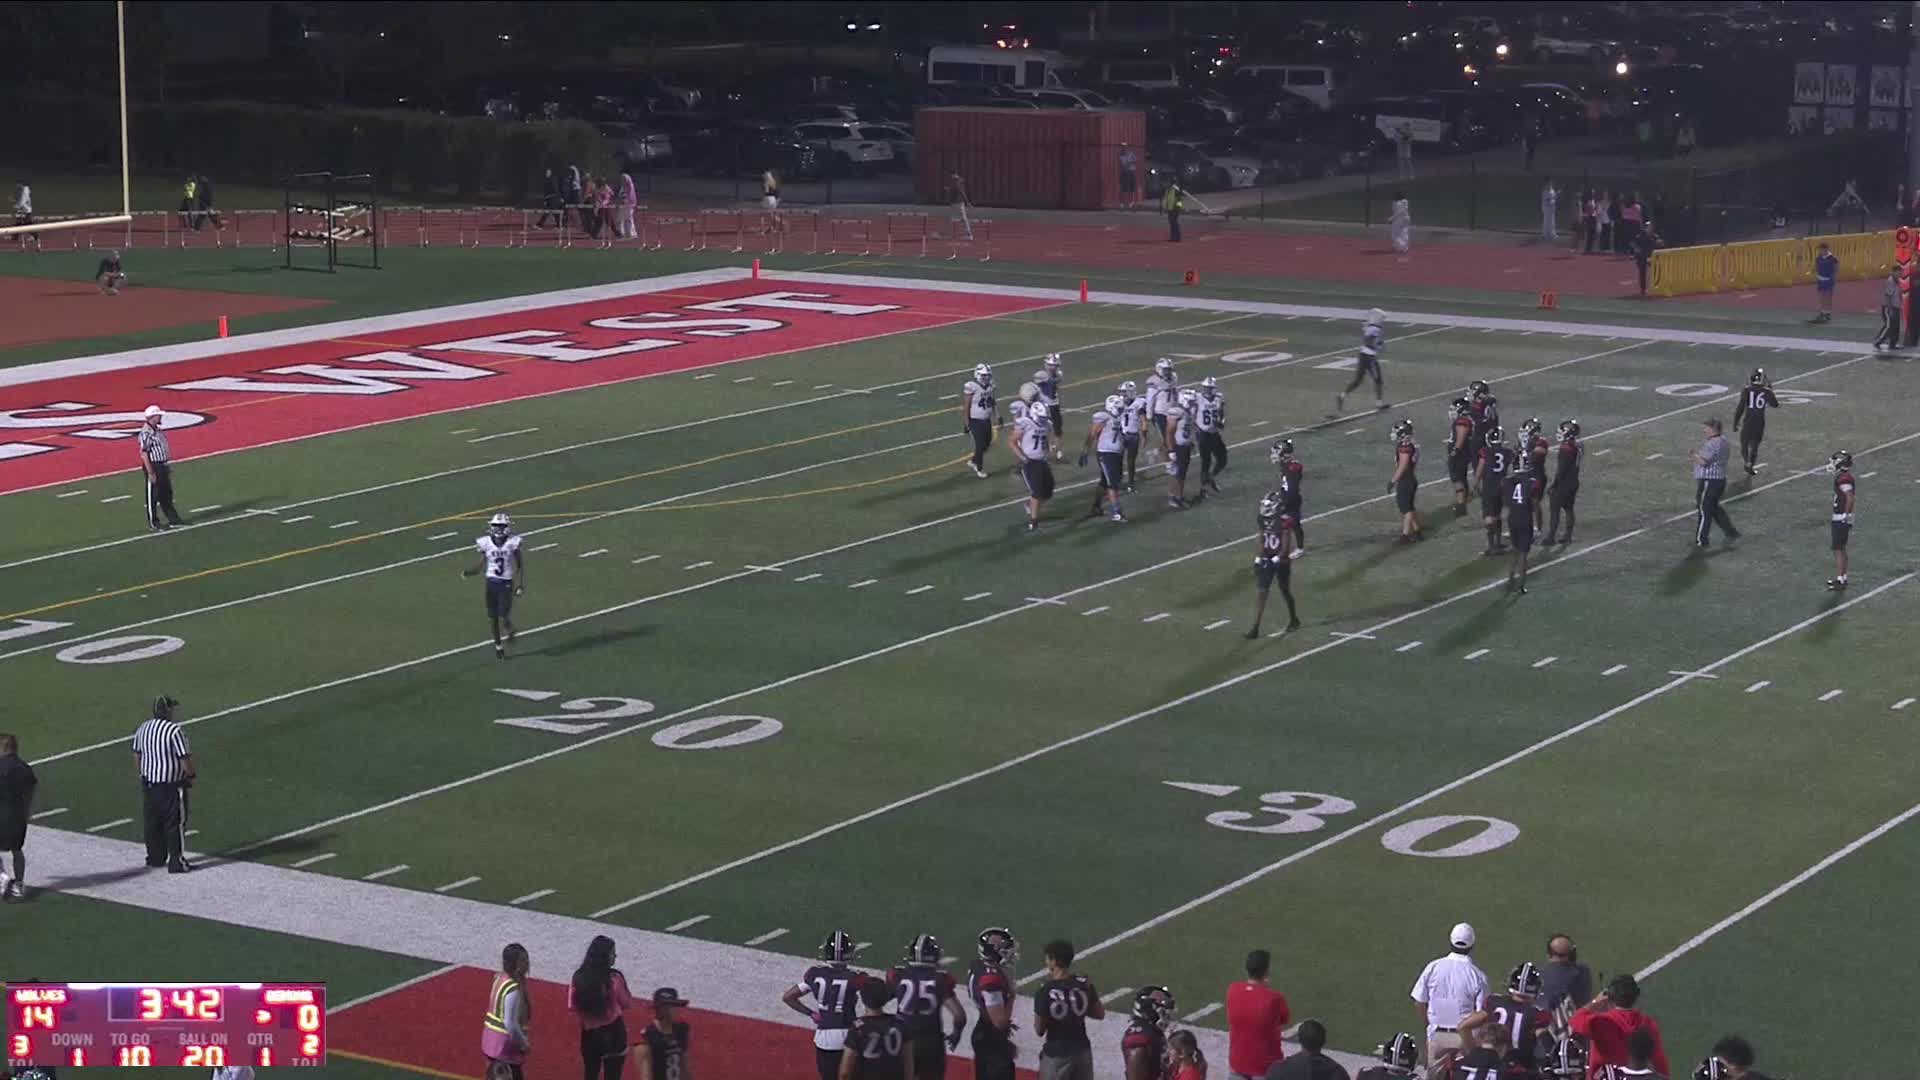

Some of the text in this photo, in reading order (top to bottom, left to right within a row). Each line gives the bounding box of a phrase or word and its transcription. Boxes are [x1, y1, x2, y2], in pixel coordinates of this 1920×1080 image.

[150, 291, 903, 395] WEST
[1748, 391, 1766, 409] 16
[1492, 452, 1504, 472] 3
[1512, 483, 1523, 504] 4
[494, 557, 504, 576] 3
[814, 976, 848, 1013] 27
[899, 979, 937, 1015] 25
[1050, 987, 1089, 1021] 80
[863, 1027, 901, 1058] 20
